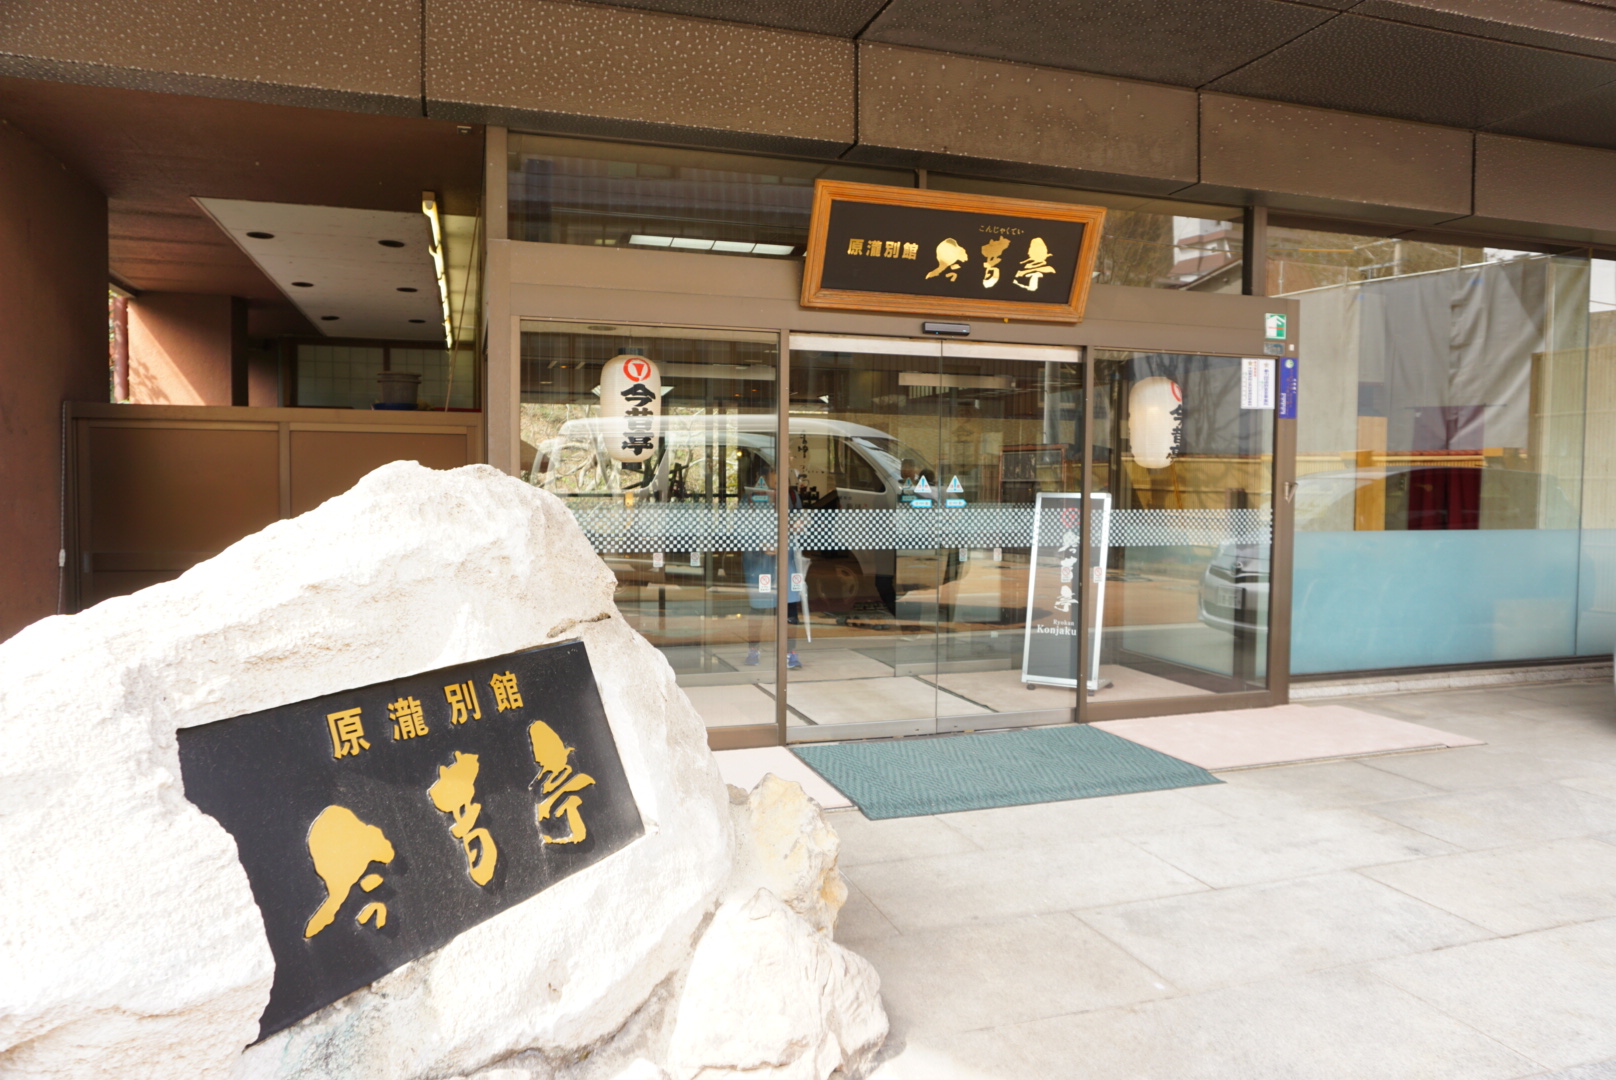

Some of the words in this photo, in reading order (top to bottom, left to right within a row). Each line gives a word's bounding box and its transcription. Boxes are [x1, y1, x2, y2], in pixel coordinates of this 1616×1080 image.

[978, 225, 1025, 236] こんじゃくてい
[847, 238, 919, 261] 原瀧別館
[621, 383, 656, 456] 今昔亭
[1037, 624, 1077, 636] Konjaku
[326, 670, 526, 761] 原瀧別館
